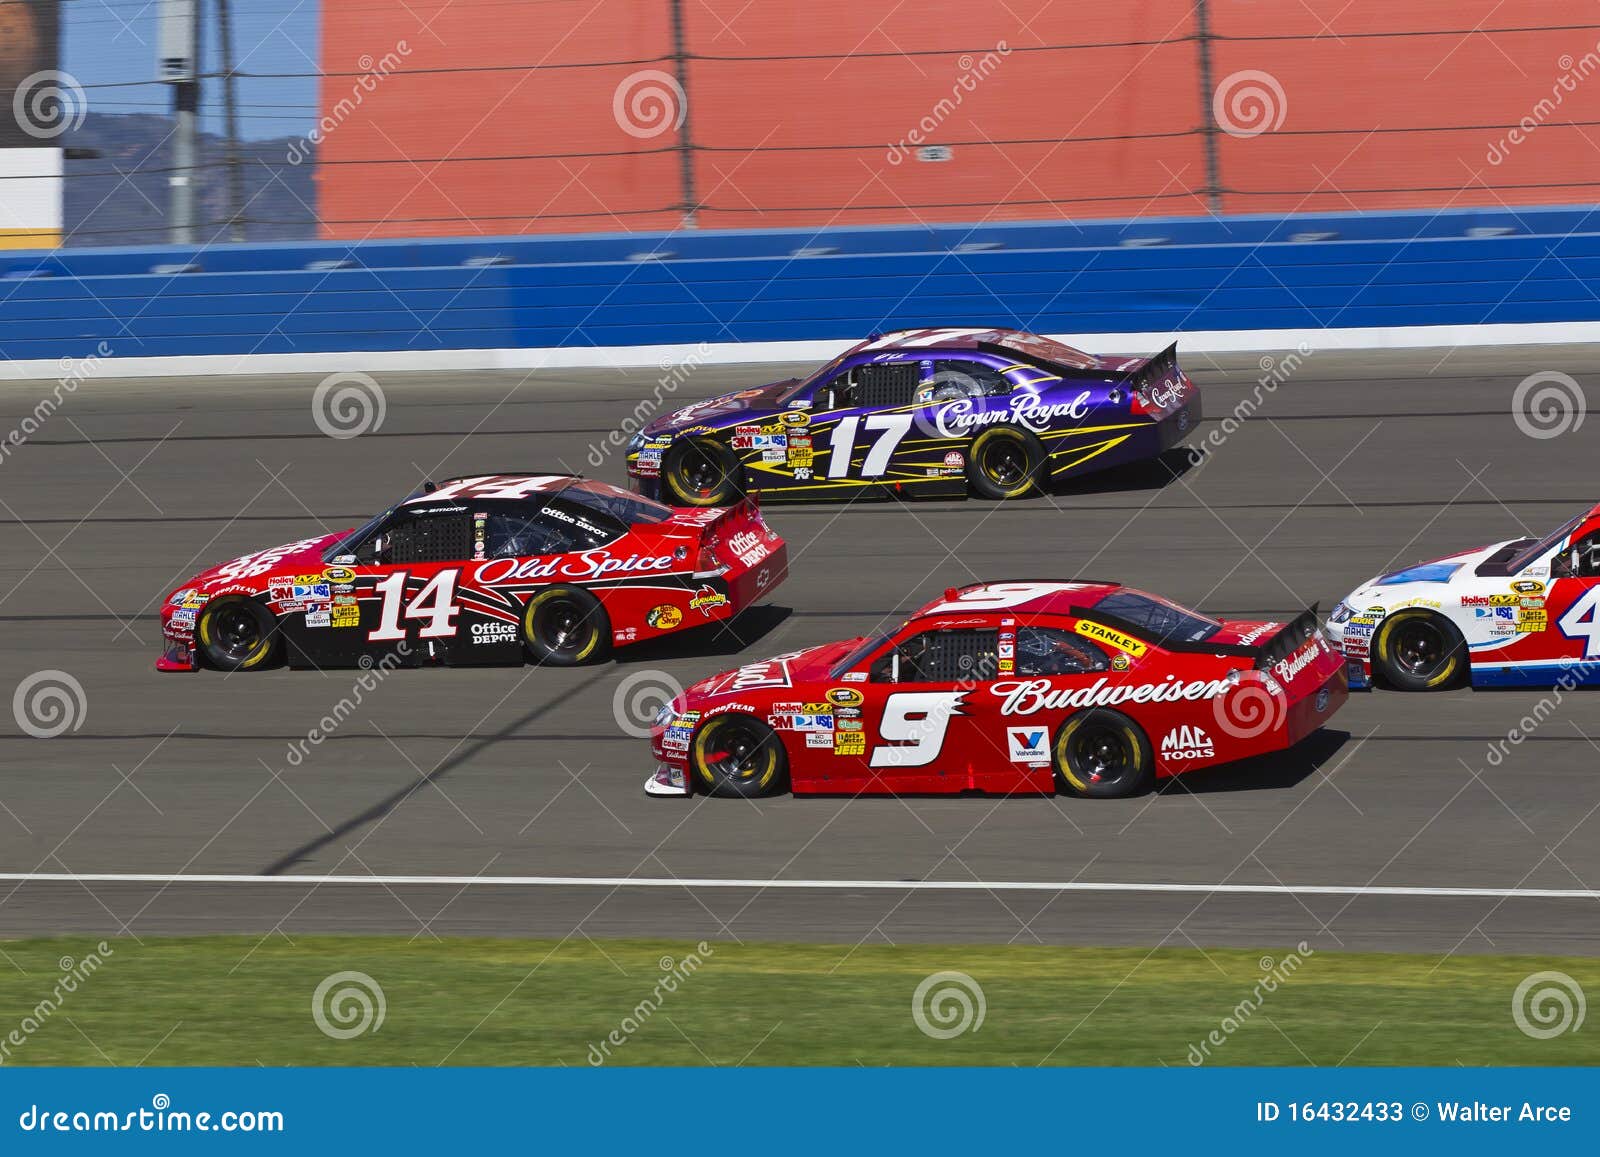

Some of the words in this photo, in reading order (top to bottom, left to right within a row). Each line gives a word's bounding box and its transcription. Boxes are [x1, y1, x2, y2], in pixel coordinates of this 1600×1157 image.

[935, 399, 1010, 439] Crown
[1008, 390, 1092, 433] Royal
[736, 426, 760, 435] Holley
[732, 436, 753, 448] 3M
[771, 435, 786, 447] USG
[828, 413, 914, 479] 17
[787, 459, 814, 468] JEGS
[403, 475, 569, 506] 14
[540, 506, 576, 524] Office
[575, 519, 609, 539] DEPOT
[728, 531, 760, 556] Office
[740, 543, 771, 568] DEPOT
[473, 557, 558, 585] Old
[560, 549, 674, 581] Spice
[269, 576, 295, 586] Holley
[210, 583, 258, 600] GOODYEAR
[271, 586, 294, 600] 3M
[313, 584, 329, 597] USG
[367, 567, 462, 641] 14
[1461, 595, 1489, 606] Holley
[1495, 606, 1513, 620] USG
[332, 617, 360, 628] JEGS
[471, 622, 516, 635] Office
[1515, 622, 1547, 633] JEGS
[1079, 621, 1143, 653] STANLEY
[1343, 626, 1371, 637] MAHLE
[472, 634, 517, 645] DEPOT
[989, 674, 1231, 717] Budweiser
[703, 702, 756, 718] GOODYEAR
[774, 703, 802, 714] Holley
[769, 715, 793, 729] 3M
[815, 715, 833, 729] USG
[868, 689, 974, 769] 9
[664, 729, 690, 741] MAHLE
[1161, 725, 1214, 752] MAC
[834, 745, 865, 756] JEGS
[1161, 749, 1216, 762] TOOLS
